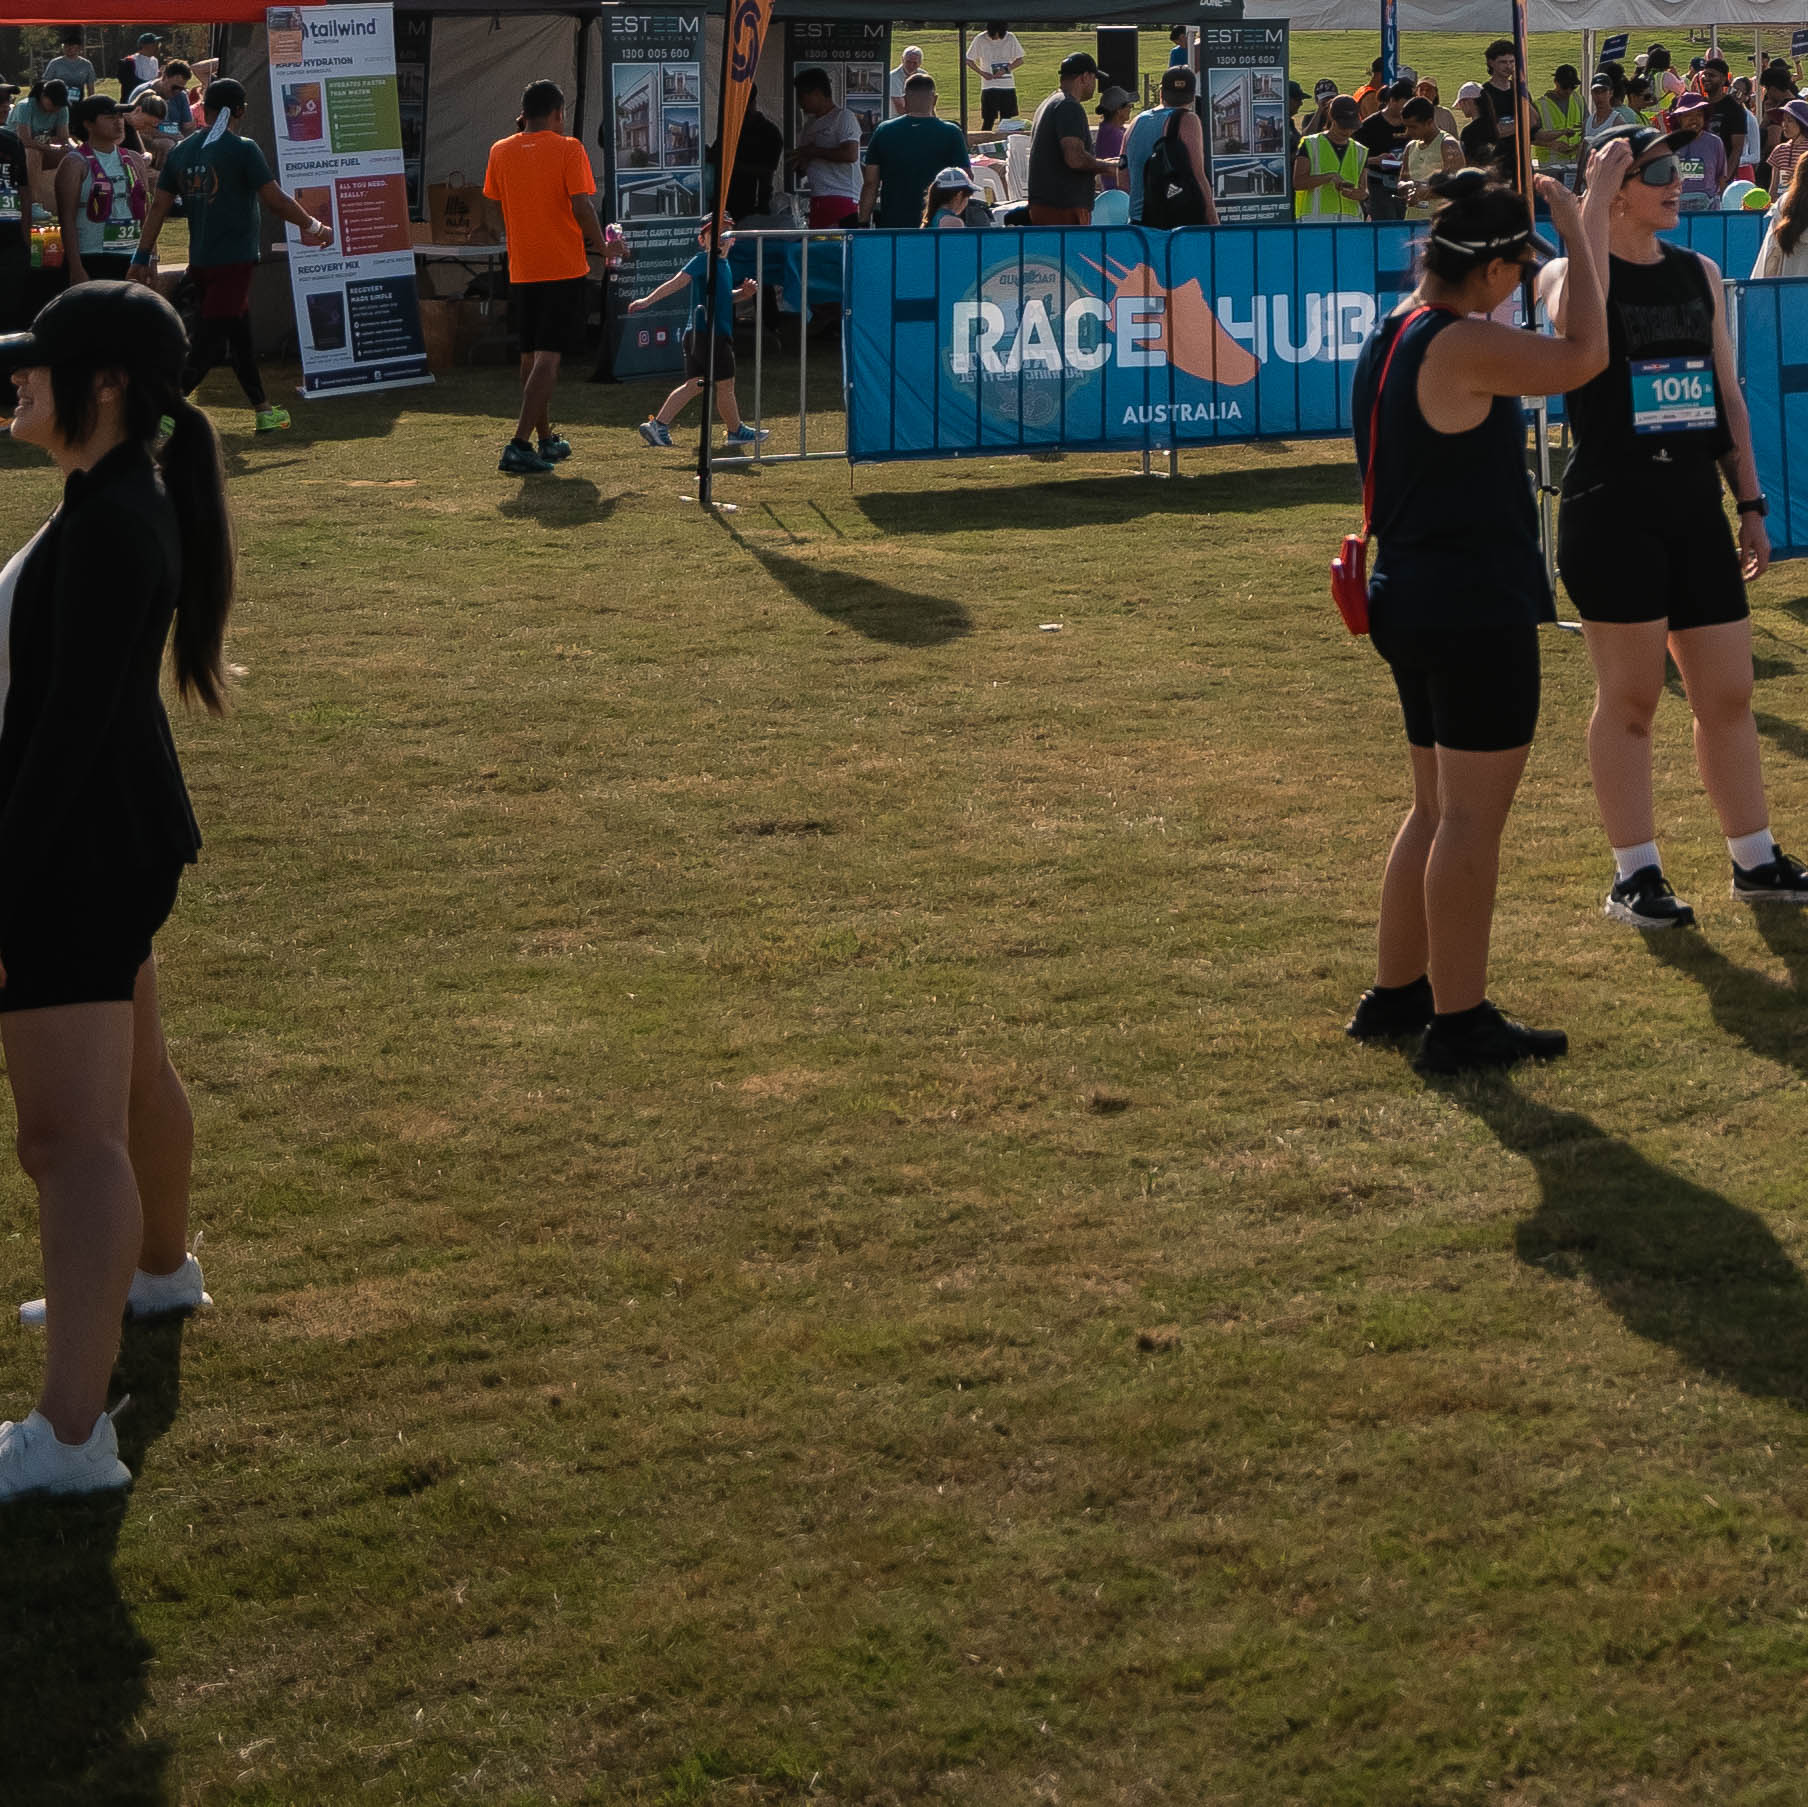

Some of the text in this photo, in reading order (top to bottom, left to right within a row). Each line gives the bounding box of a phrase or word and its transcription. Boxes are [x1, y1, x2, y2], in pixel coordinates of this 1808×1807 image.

[310, 18, 377, 38] tailwind
[611, 16, 699, 33] ESTEEM
[1208, 29, 1283, 44] ESTEEM
[622, 48, 690, 59] 1300 005 600
[1239, 56, 1257, 65] 005
[303, 57, 353, 67] HYDRATION
[286, 157, 361, 171] ENDURANCE FUEL
[298, 262, 343, 274] RECOVERY
[952, 291, 1376, 374] RACE HUB
[1652, 376, 1703, 402] 1016
[1122, 401, 1243, 425] AUSTRALIA
